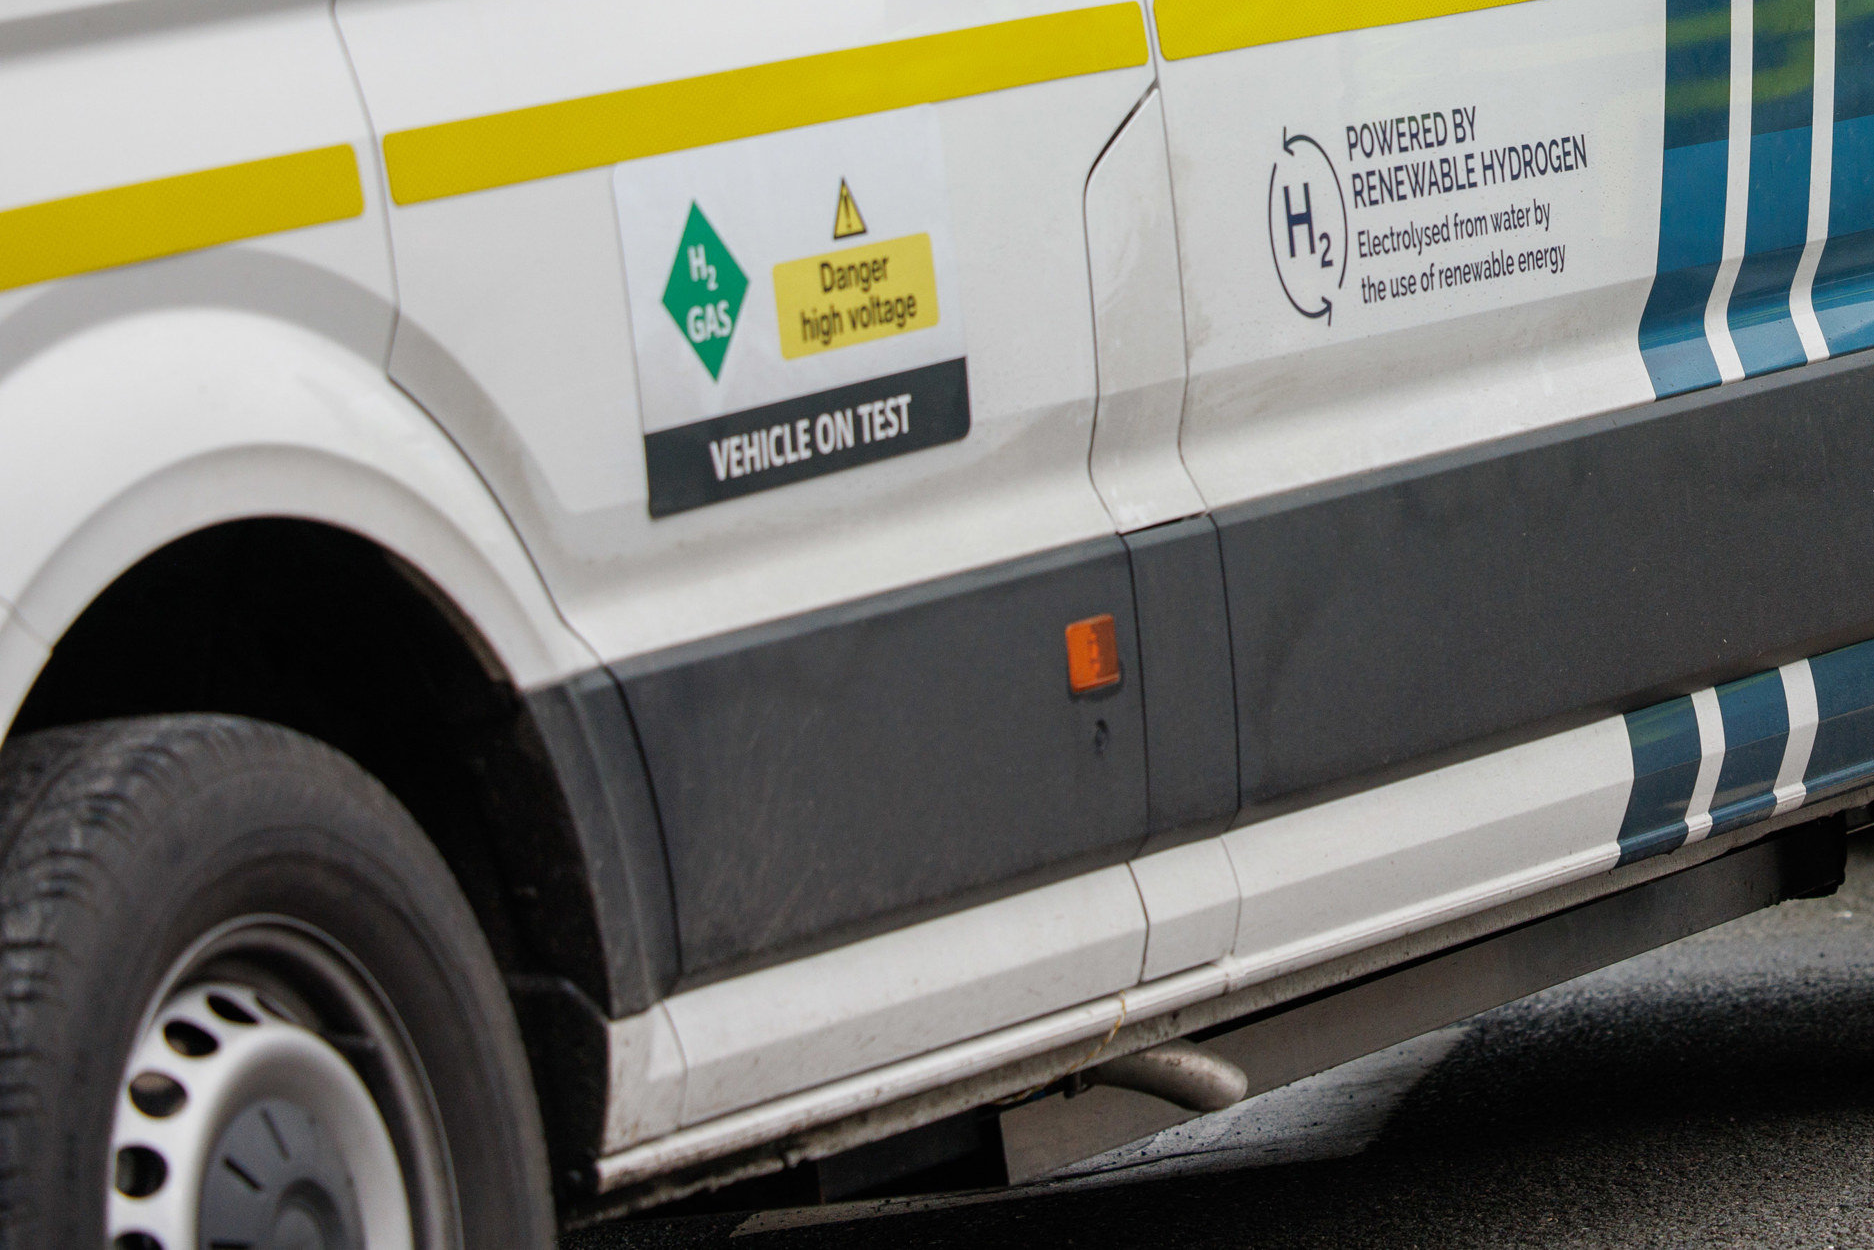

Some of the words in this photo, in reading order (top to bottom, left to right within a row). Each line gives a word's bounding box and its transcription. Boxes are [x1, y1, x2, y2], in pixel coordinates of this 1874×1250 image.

[1346, 111, 1448, 162] POWERED
[1451, 105, 1477, 144] BY
[1351, 153, 1478, 209] RENEWABLE
[1480, 133, 1588, 187] HYDROGEN
[1358, 214, 1451, 259] Electrolysed
[1453, 212, 1488, 241] from
[1491, 206, 1531, 232] water
[1534, 198, 1551, 232] by
[819, 255, 890, 294] Danger
[1361, 275, 1386, 304] the
[1390, 274, 1416, 298] use
[1420, 262, 1436, 292] of
[1438, 248, 1515, 290] renewable
[1518, 244, 1566, 274] energy
[686, 299, 732, 344] GAS
[800, 306, 844, 346] high
[848, 293, 918, 333] voltage
[710, 418, 812, 482] VEHICLE
[815, 408, 854, 455] ON
[857, 393, 912, 444] TEST
